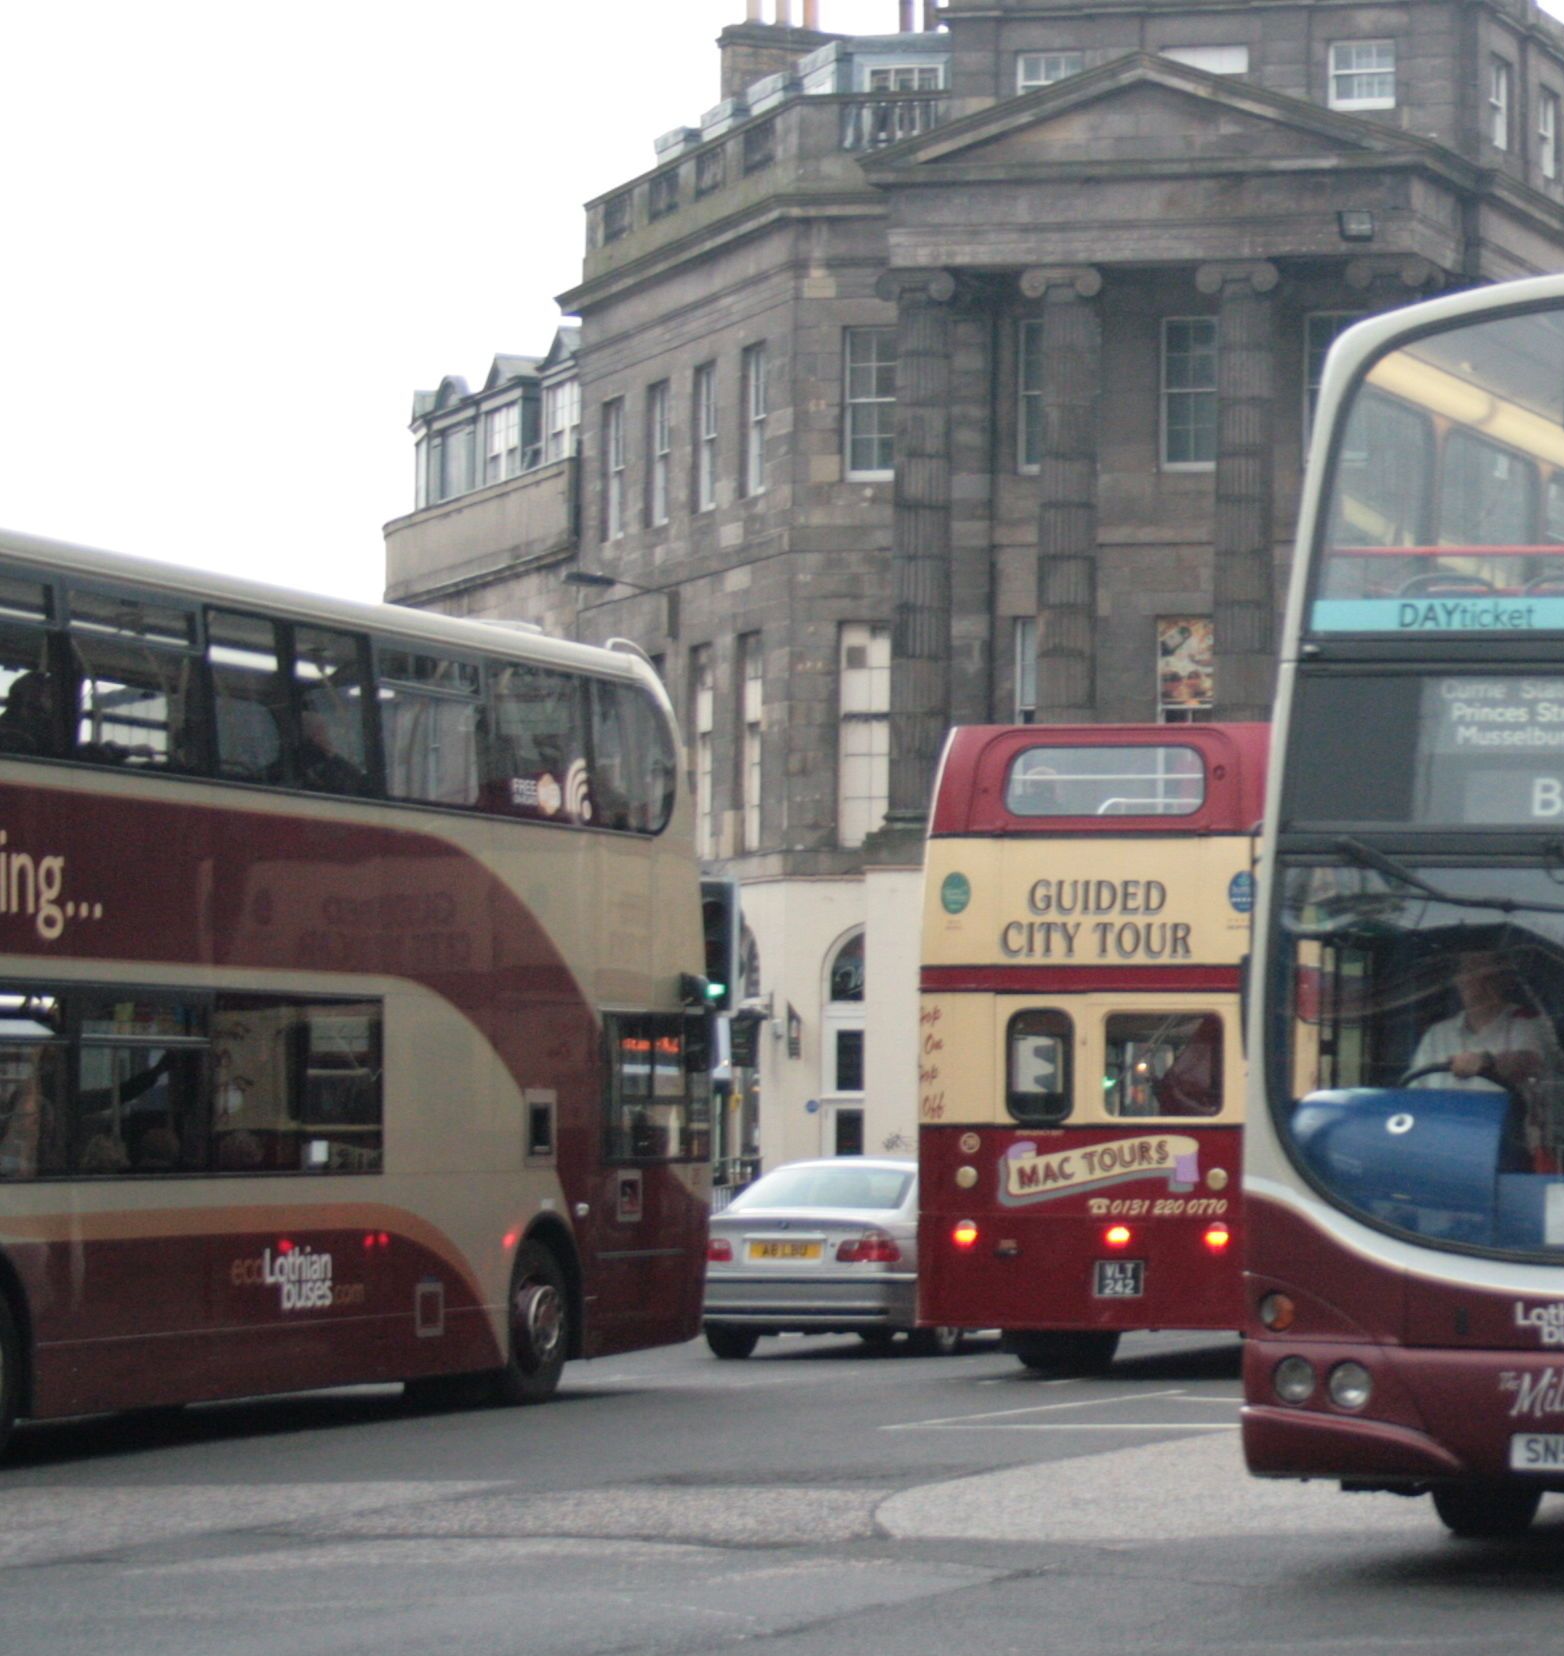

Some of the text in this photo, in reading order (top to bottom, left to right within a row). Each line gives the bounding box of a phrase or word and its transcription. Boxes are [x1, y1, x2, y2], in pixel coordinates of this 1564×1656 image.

[1399, 603, 1535, 629] DAYticket
[1451, 702, 1530, 722] Princes
[1028, 878, 1168, 916] GUIDED
[1001, 920, 1193, 959] CITY TOUR
[1016, 1139, 1170, 1190] MAC TOURS
[1110, 1198, 1228, 1215] 0131 220 0770
[1104, 1262, 1136, 1278] VLT
[1104, 1279, 1136, 1294] 242
